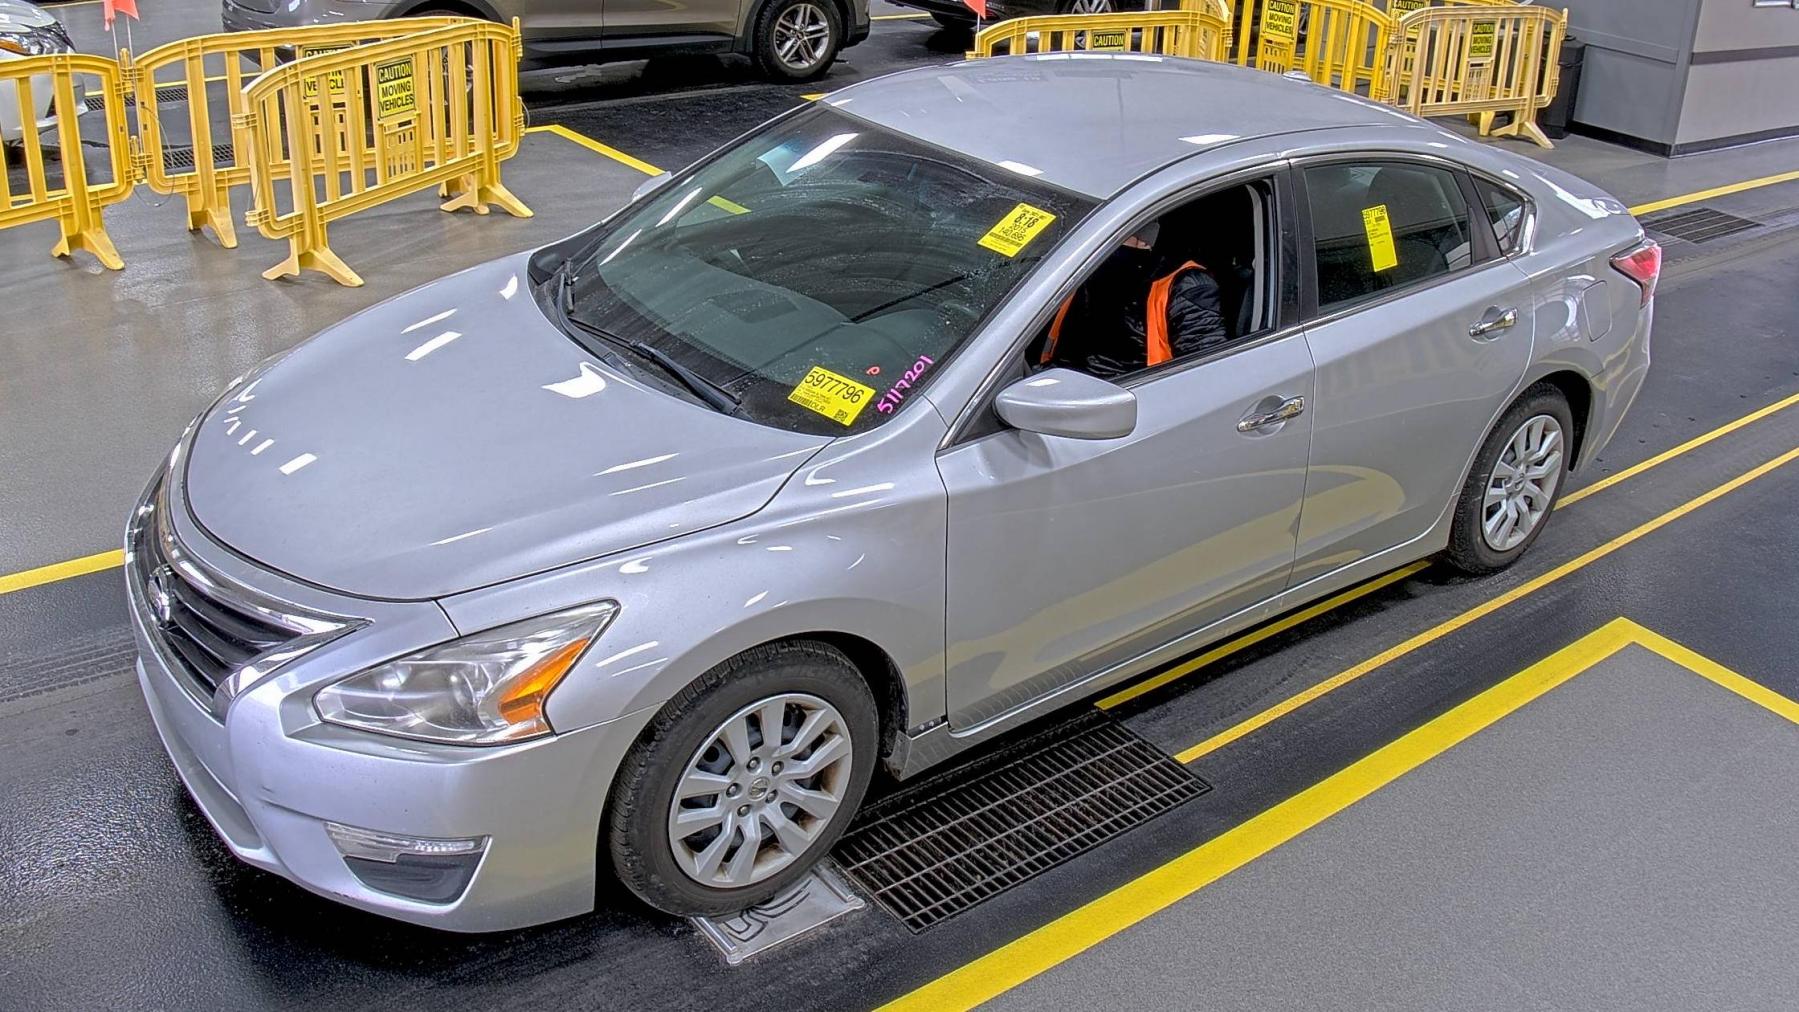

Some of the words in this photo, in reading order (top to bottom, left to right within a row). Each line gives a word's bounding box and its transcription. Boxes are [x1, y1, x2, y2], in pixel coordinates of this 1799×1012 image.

[1269, 1, 1294, 13] CAUTION
[1269, 13, 1292, 24] MOVING
[1266, 22, 1293, 34] VEHICLES
[1094, 34, 1124, 46] CAUTION
[378, 61, 412, 82] CAUTION
[382, 81, 412, 97] MOVING
[379, 94, 415, 111] VEHICLES
[1009, 223, 1027, 233] 2015
[1014, 213, 1039, 228] 8:18
[804, 370, 865, 404] 5977796
[877, 355, 934, 414] 5117201
